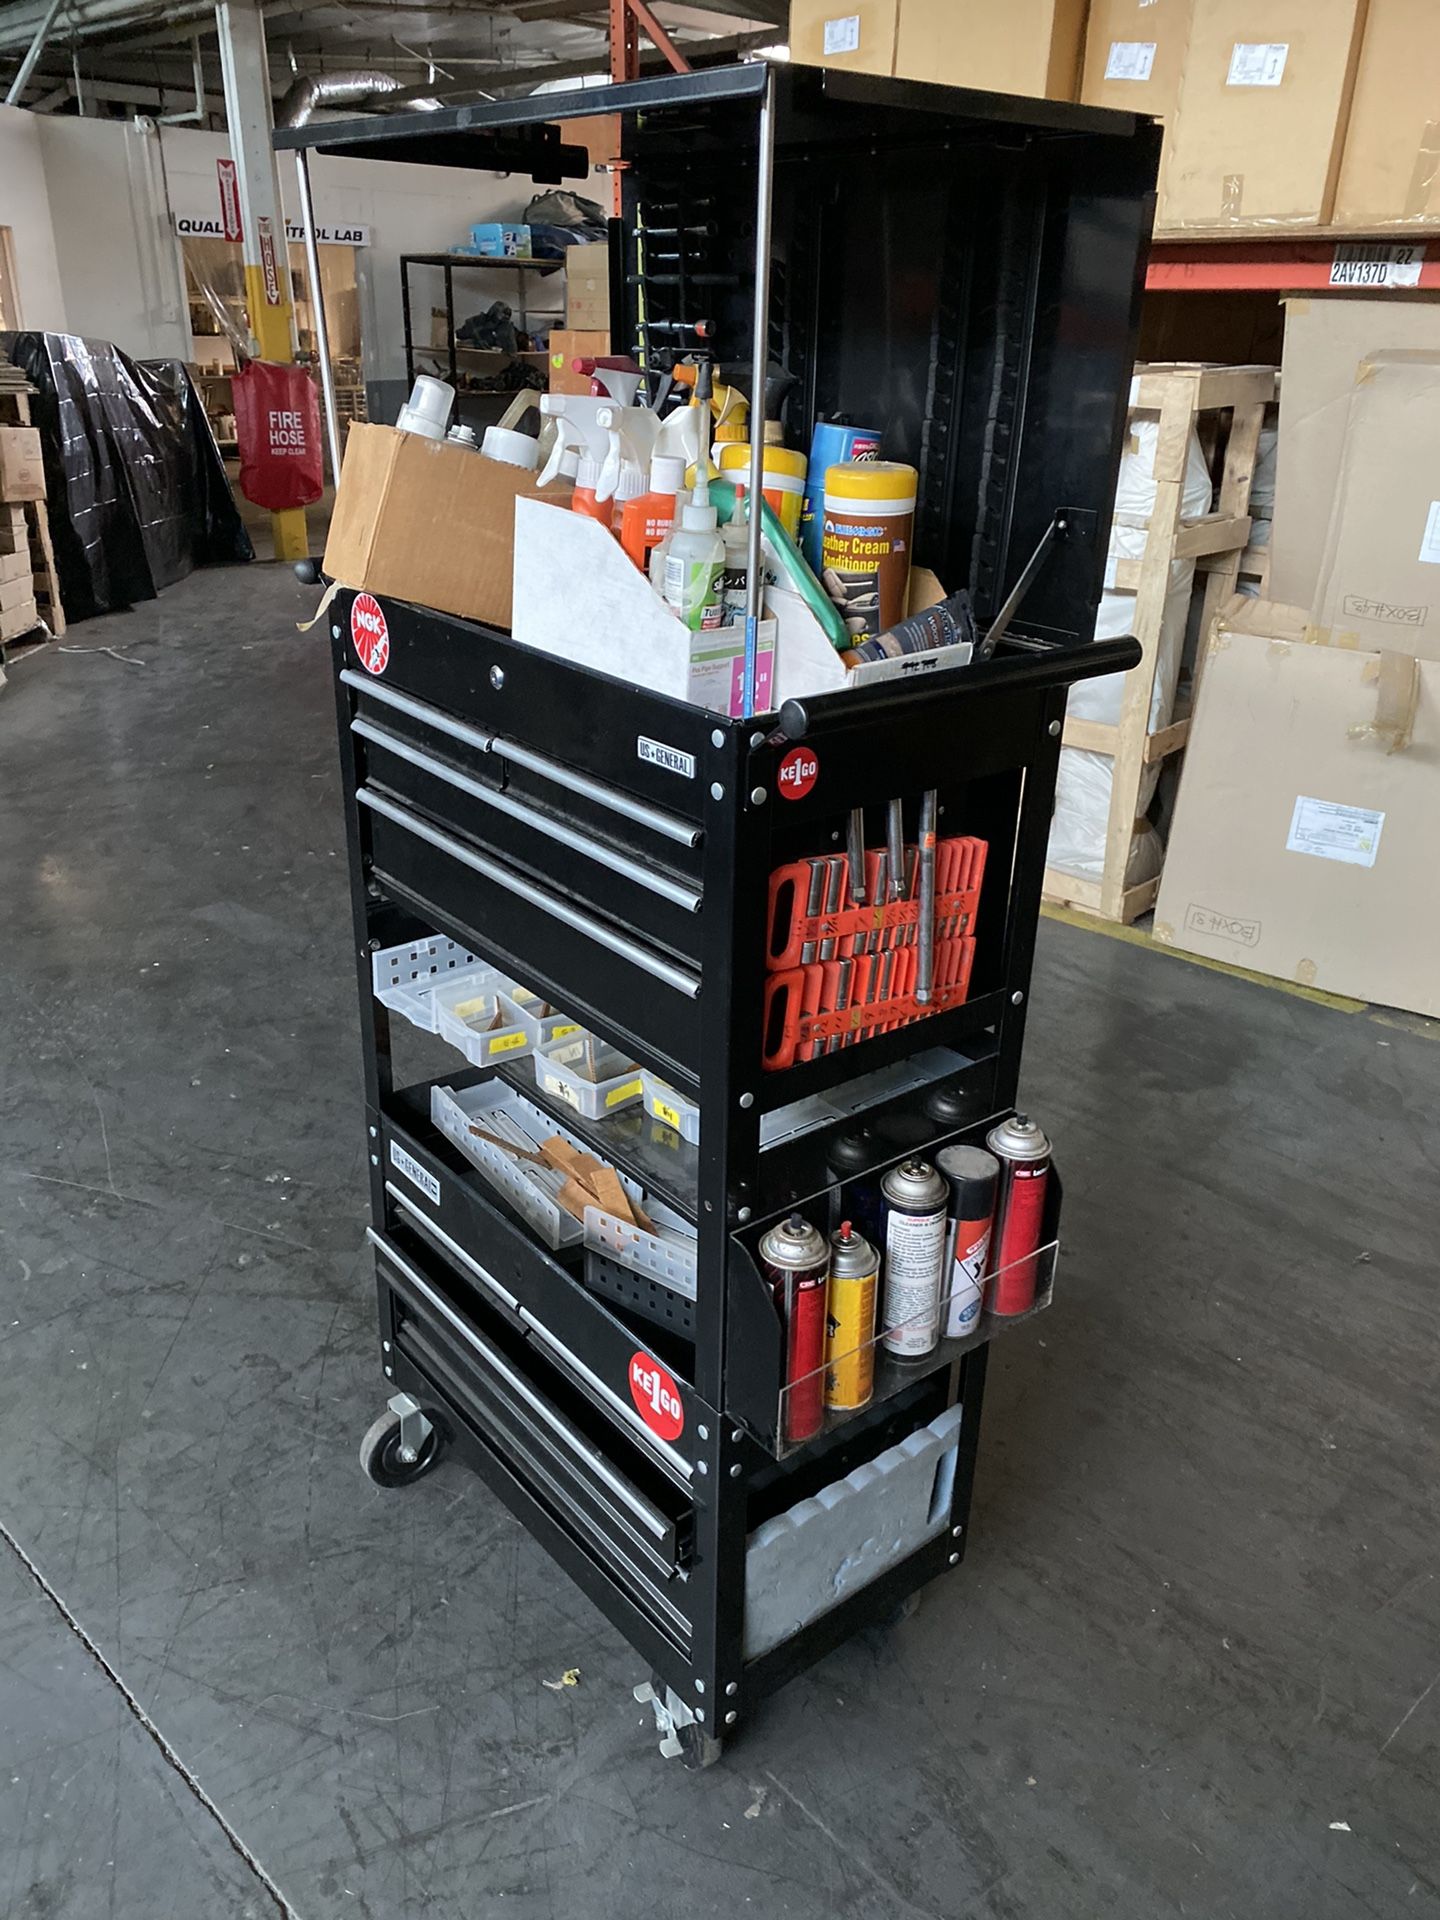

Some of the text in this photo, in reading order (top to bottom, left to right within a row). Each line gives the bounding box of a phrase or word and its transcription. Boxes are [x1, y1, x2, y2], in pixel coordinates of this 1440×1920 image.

[178, 219, 223, 233] QUAL
[334, 230, 363, 242] LAB
[262, 237, 276, 298] HOSE
[1331, 262, 1388, 283] 2AV137D
[269, 411, 303, 429] FIRE
[269, 430, 306, 446] HOSE
[271, 447, 306, 456] KEEP CLEAR
[646, 519, 656, 527] NO
[823, 535, 890, 555] eather Cream
[823, 550, 880, 573] Conditioner
[355, 610, 383, 637] NGK
[640, 741, 690, 775] US GENERAL
